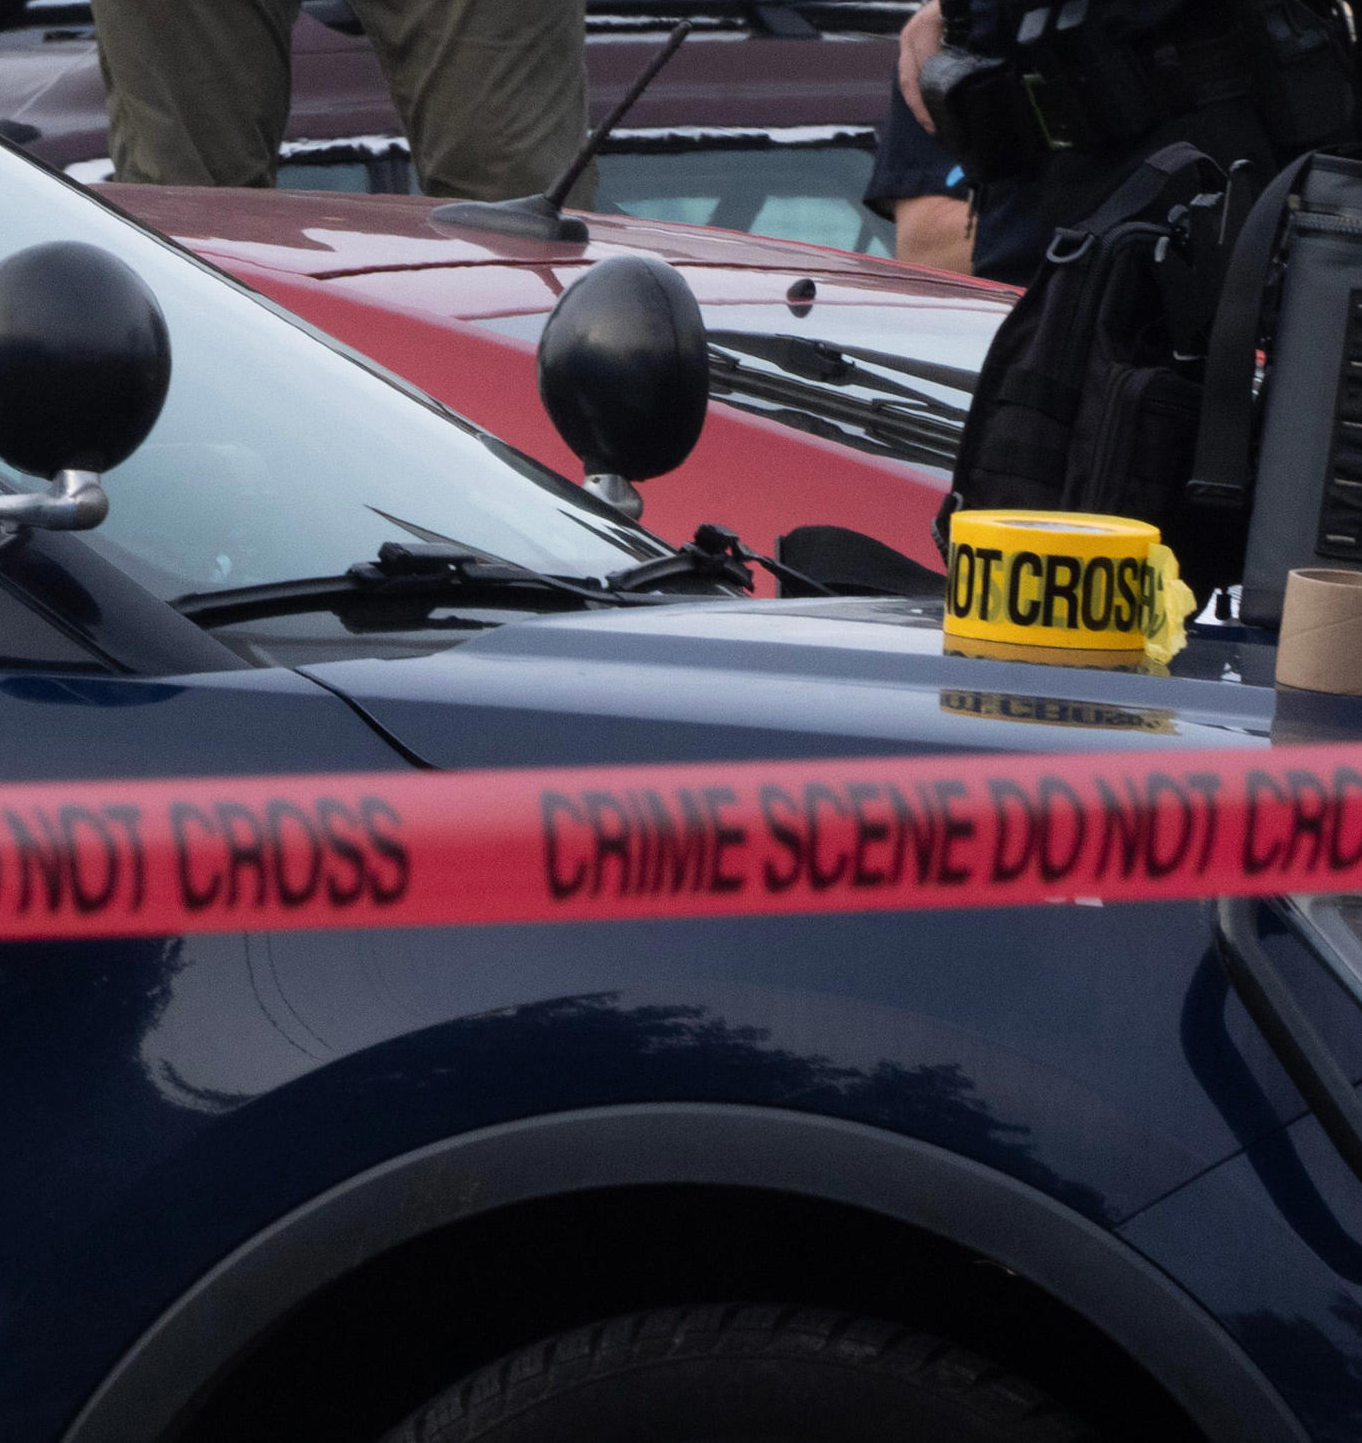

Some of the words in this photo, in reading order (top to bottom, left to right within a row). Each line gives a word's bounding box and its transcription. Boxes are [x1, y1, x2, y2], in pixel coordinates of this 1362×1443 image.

[1007, 550, 1146, 633] CROS
[1, 801, 148, 915] NOT
[169, 795, 412, 912] CROSS
[540, 784, 747, 901] CRIME
[757, 778, 976, 893] SCENE
[987, 772, 1087, 885] DO
[1093, 769, 1223, 881] NOT
